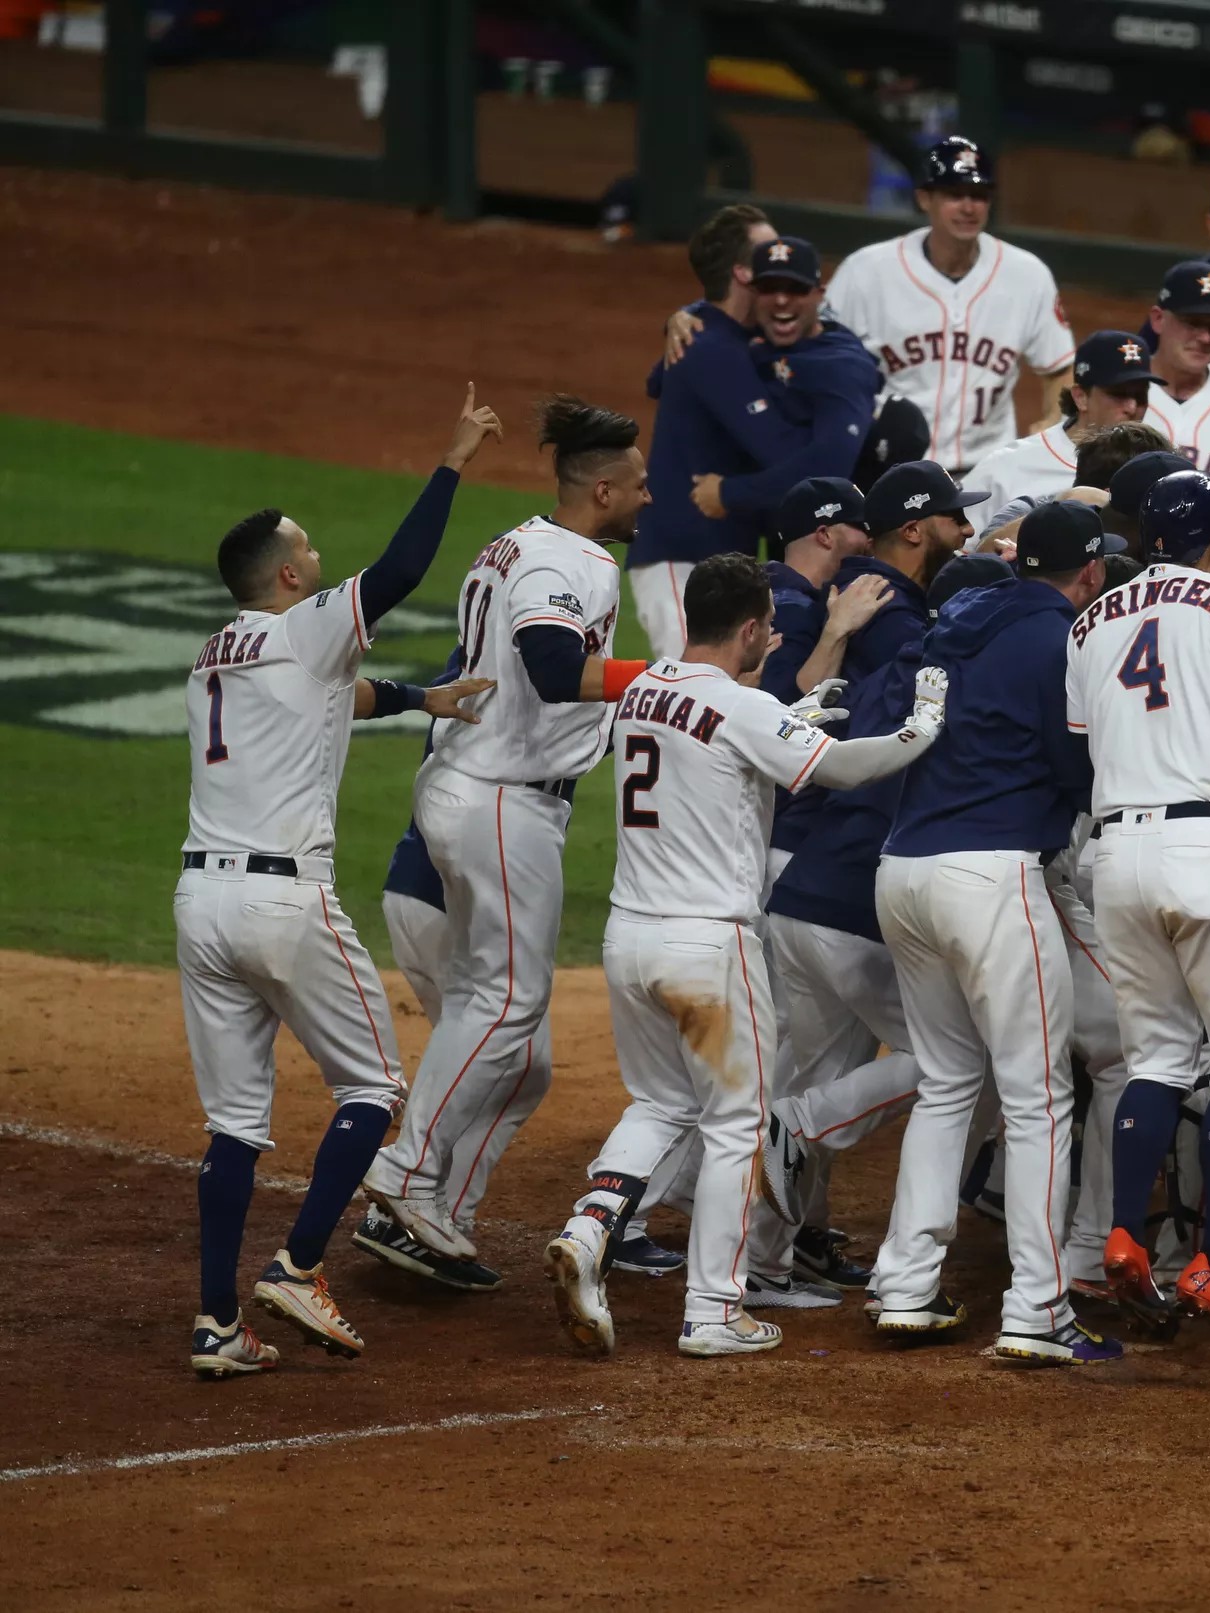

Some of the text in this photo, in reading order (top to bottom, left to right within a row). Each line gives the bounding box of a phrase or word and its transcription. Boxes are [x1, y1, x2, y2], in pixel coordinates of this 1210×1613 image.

[879, 330, 1017, 376] ASTROS
[1117, 617, 1170, 712] 4
[205, 671, 229, 765] 1
[623, 735, 660, 829] 2
